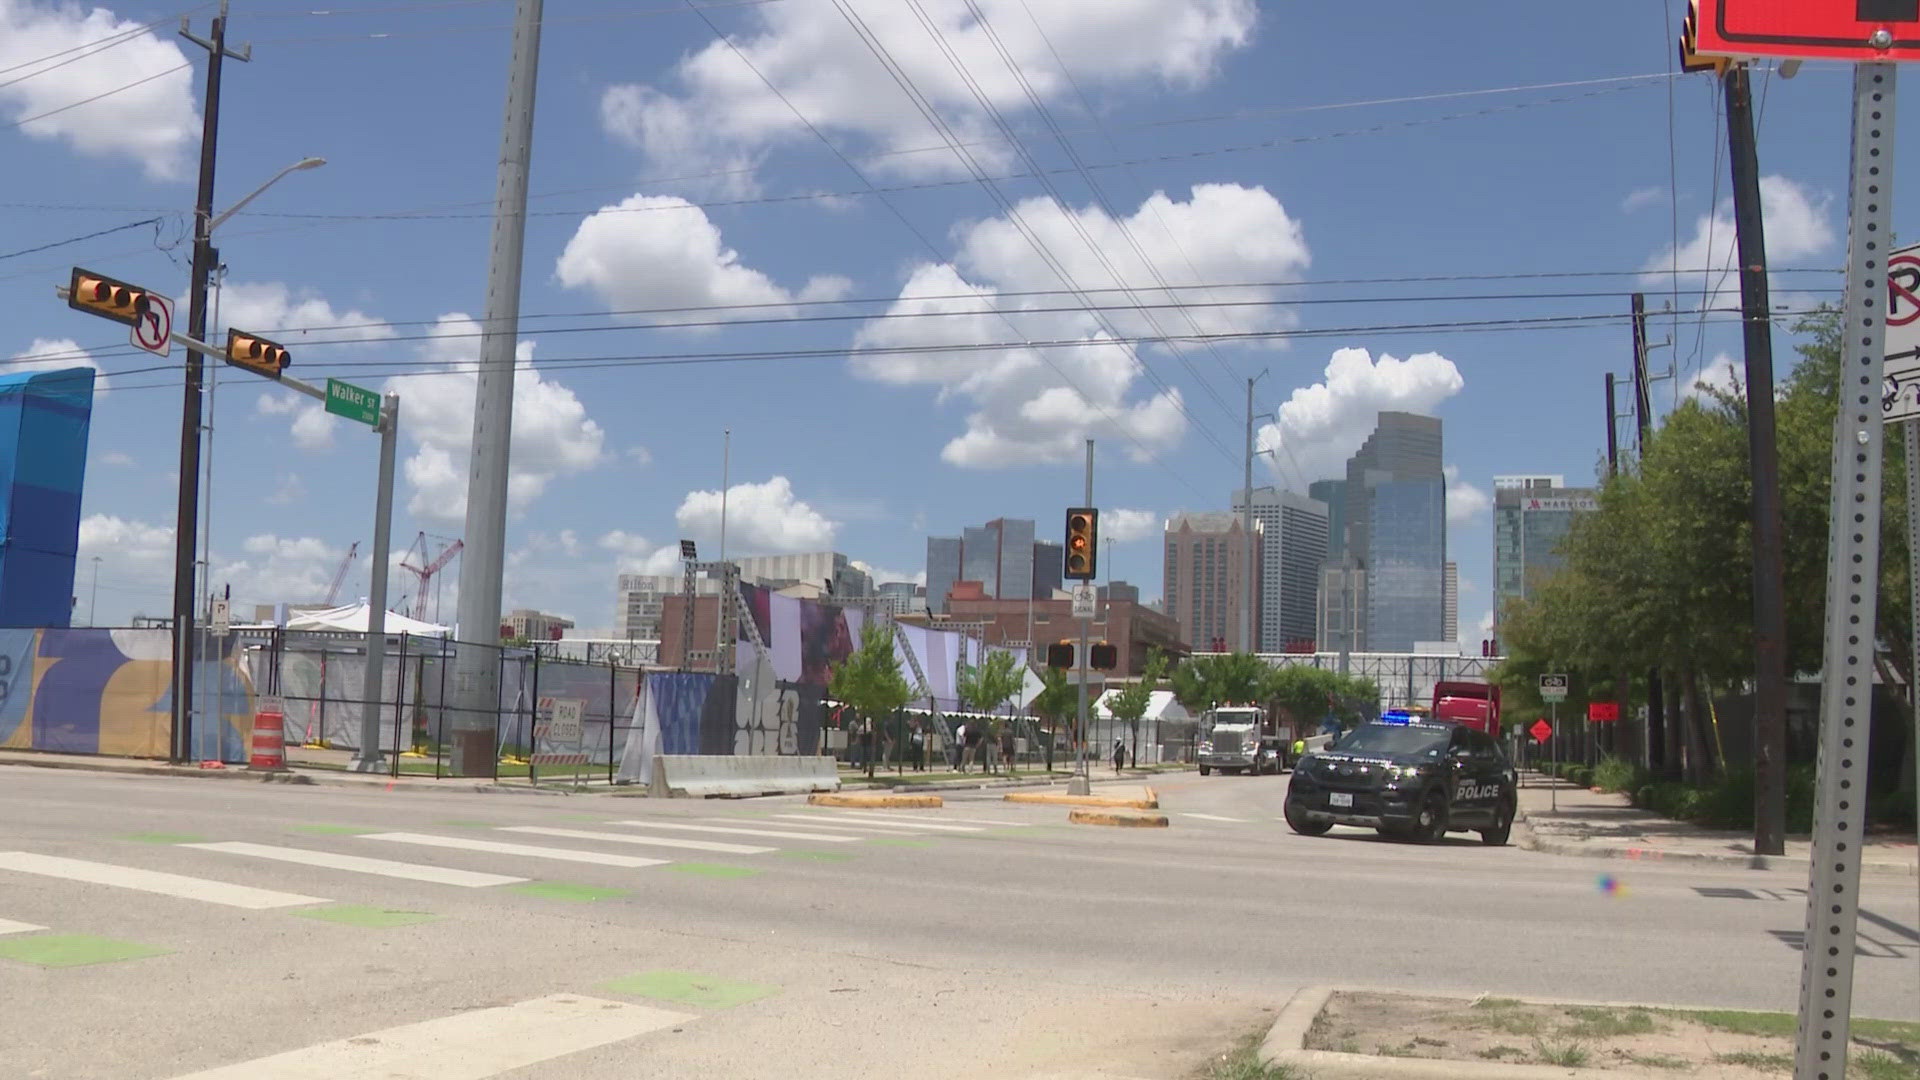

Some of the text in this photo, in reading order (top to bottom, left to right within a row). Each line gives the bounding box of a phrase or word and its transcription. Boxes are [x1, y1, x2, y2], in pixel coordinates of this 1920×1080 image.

[331, 383, 364, 405] Walker
[623, 578, 655, 590] Hilton
[559, 705, 576, 719] ROAD
[553, 722, 577, 737] CLOSED
[1456, 785, 1499, 800] POLICE
